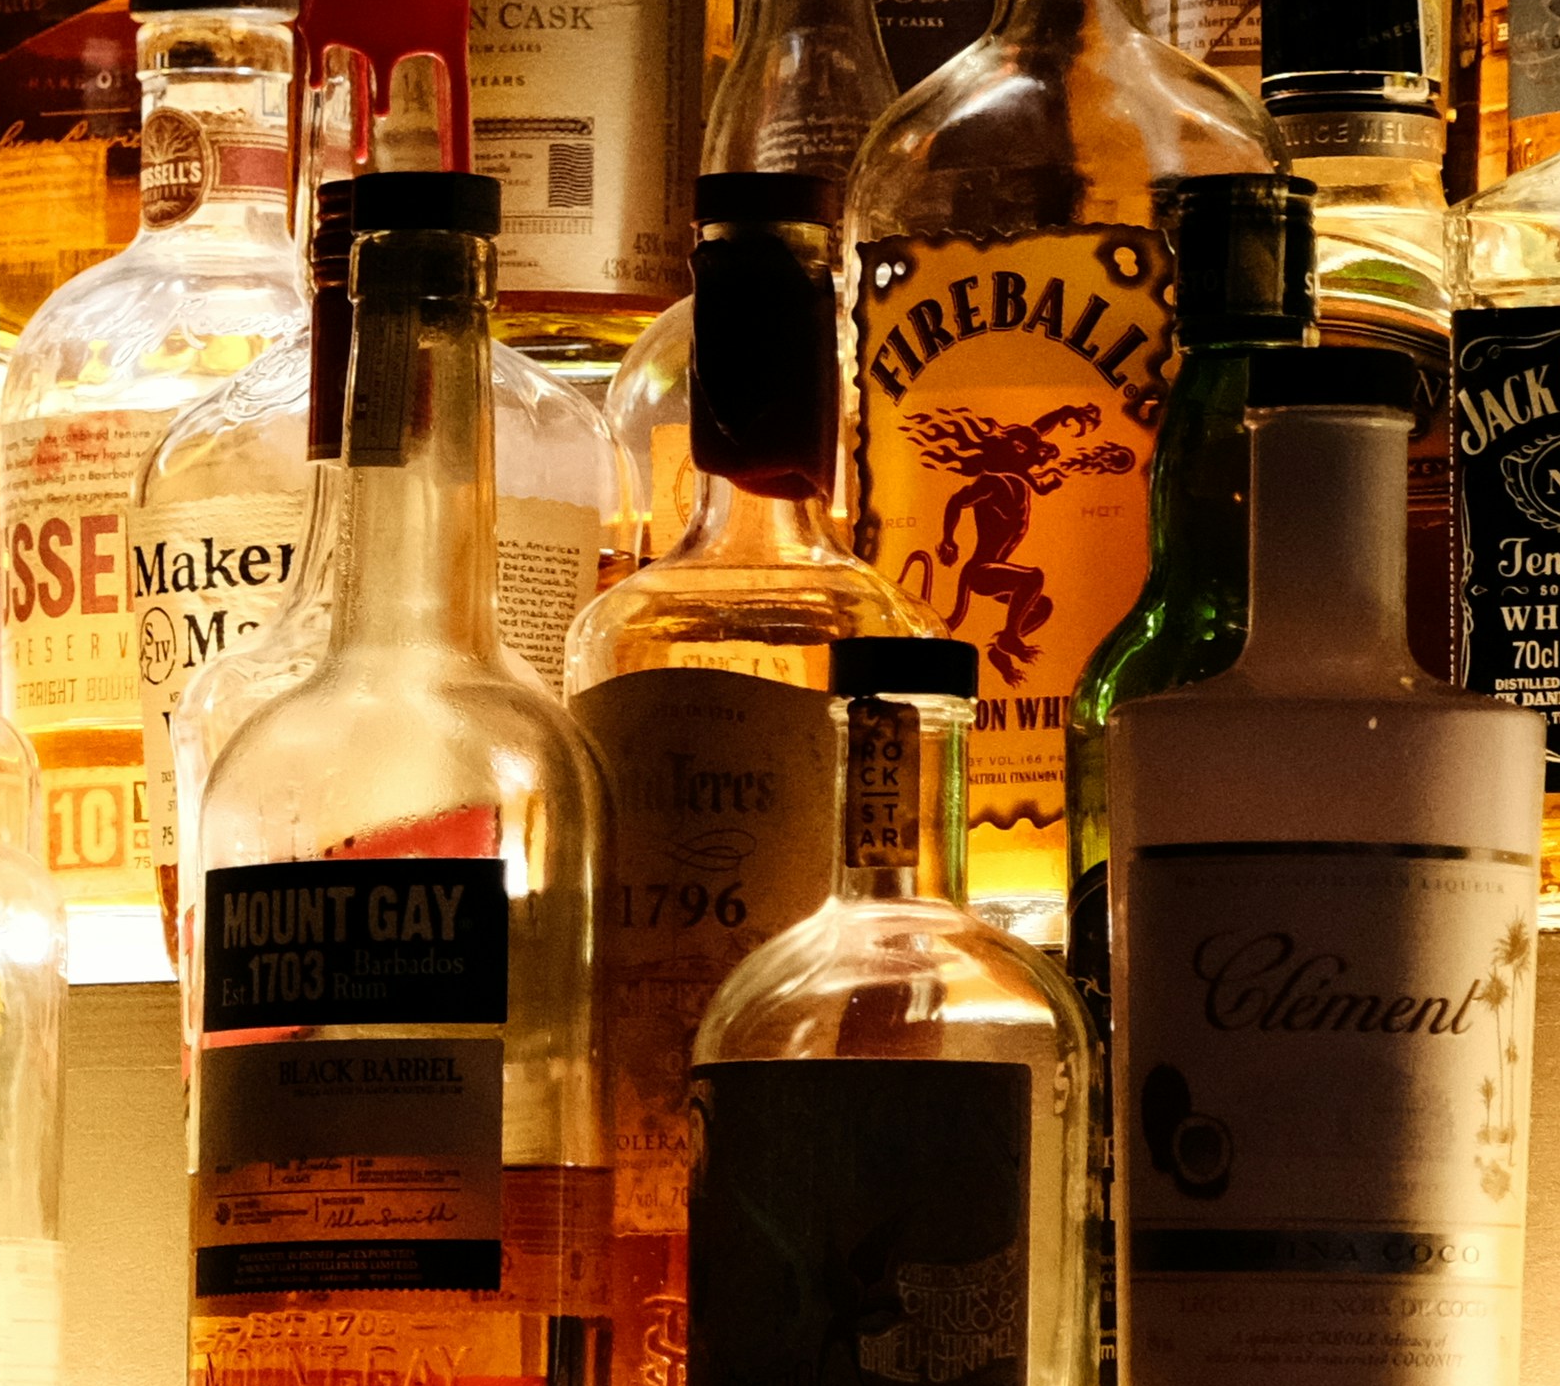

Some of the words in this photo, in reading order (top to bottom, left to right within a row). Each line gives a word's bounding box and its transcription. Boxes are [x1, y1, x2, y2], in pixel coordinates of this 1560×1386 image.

[499, 3, 593, 30] CASK
[900, 17, 944, 28] CASKS
[470, 75, 525, 87] YEARS
[870, 271, 1149, 407] FIREBALL
[1457, 364, 1560, 456] JACK
[532, 587, 577, 599] Kentucky
[1512, 641, 1558, 669] 70cl
[1495, 677, 1560, 691] DISTILLED
[53, 789, 116, 865] 10
[224, 886, 356, 949] MOUNT
[368, 884, 466, 941] GAY
[621, 883, 747, 928] 1796
[352, 947, 465, 976] Barbados
[248, 949, 326, 1005] 1703
[332, 973, 389, 1001] Rum
[1192, 932, 1481, 1035] Clément
[280, 1059, 353, 1085] BLACK
[362, 1057, 462, 1082] BARREL
[1382, 1242, 1482, 1265] COCO
